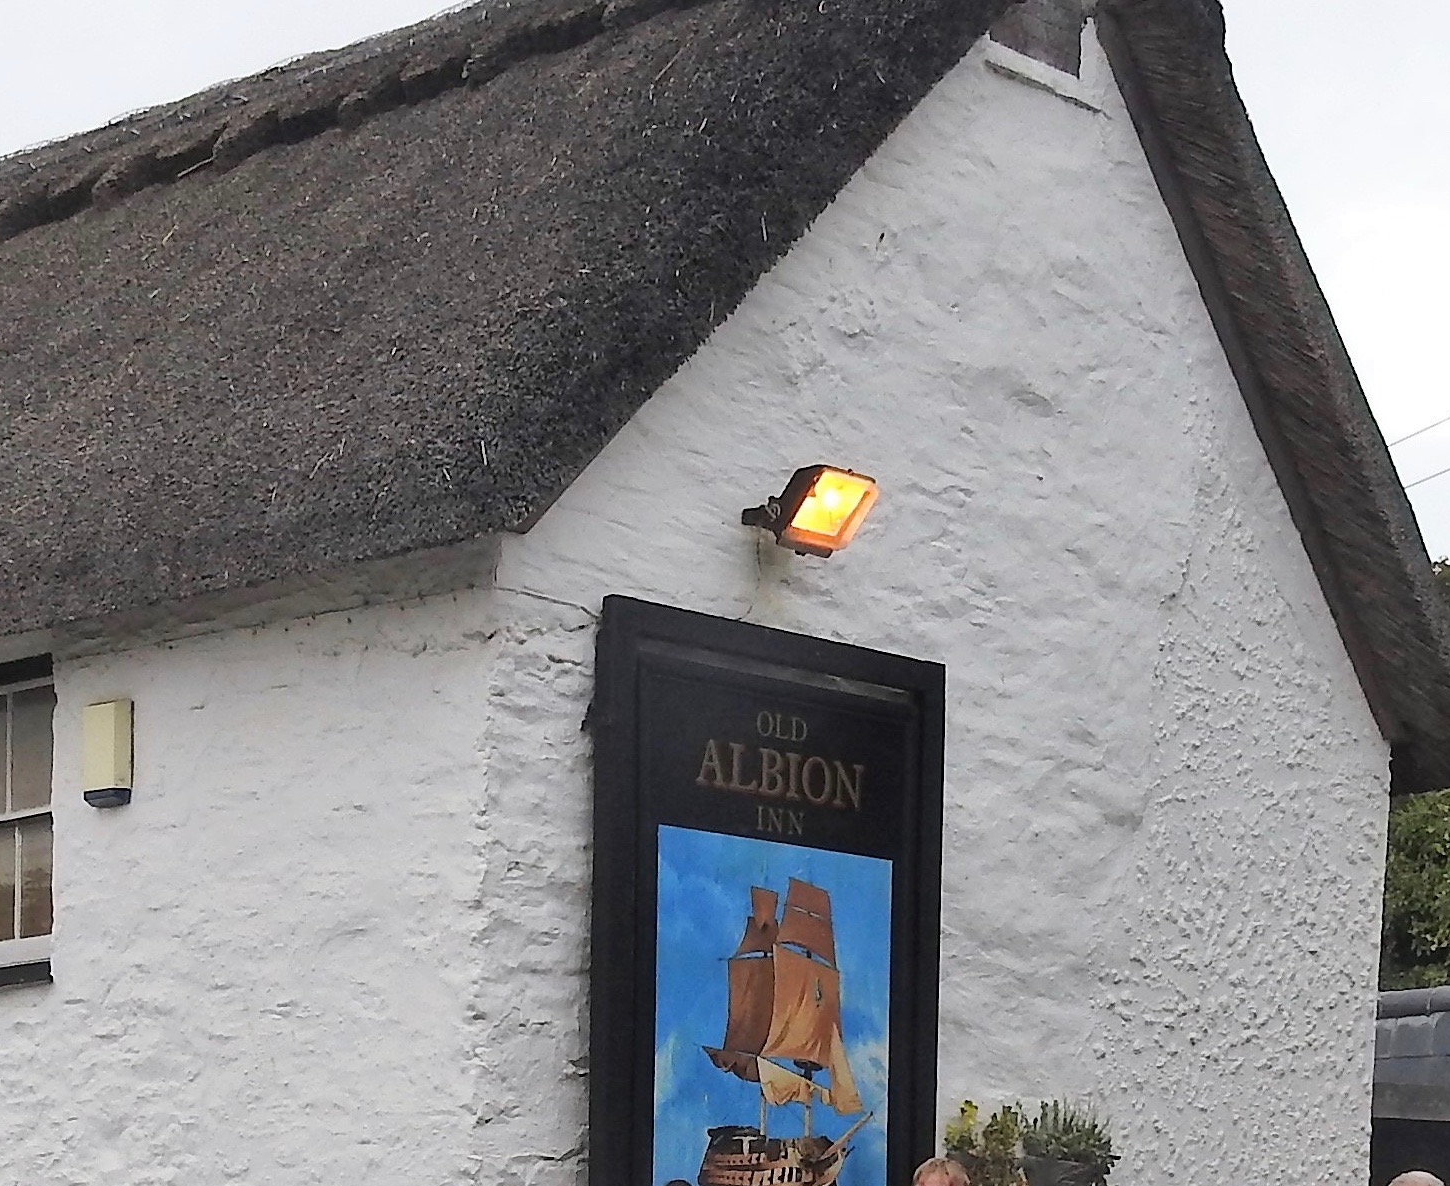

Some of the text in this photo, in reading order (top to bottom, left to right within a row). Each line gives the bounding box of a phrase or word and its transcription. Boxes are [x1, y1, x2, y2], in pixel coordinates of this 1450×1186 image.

[756, 710, 808, 742] OLD
[695, 738, 866, 812] ALBION
[756, 804, 806, 836] INN
